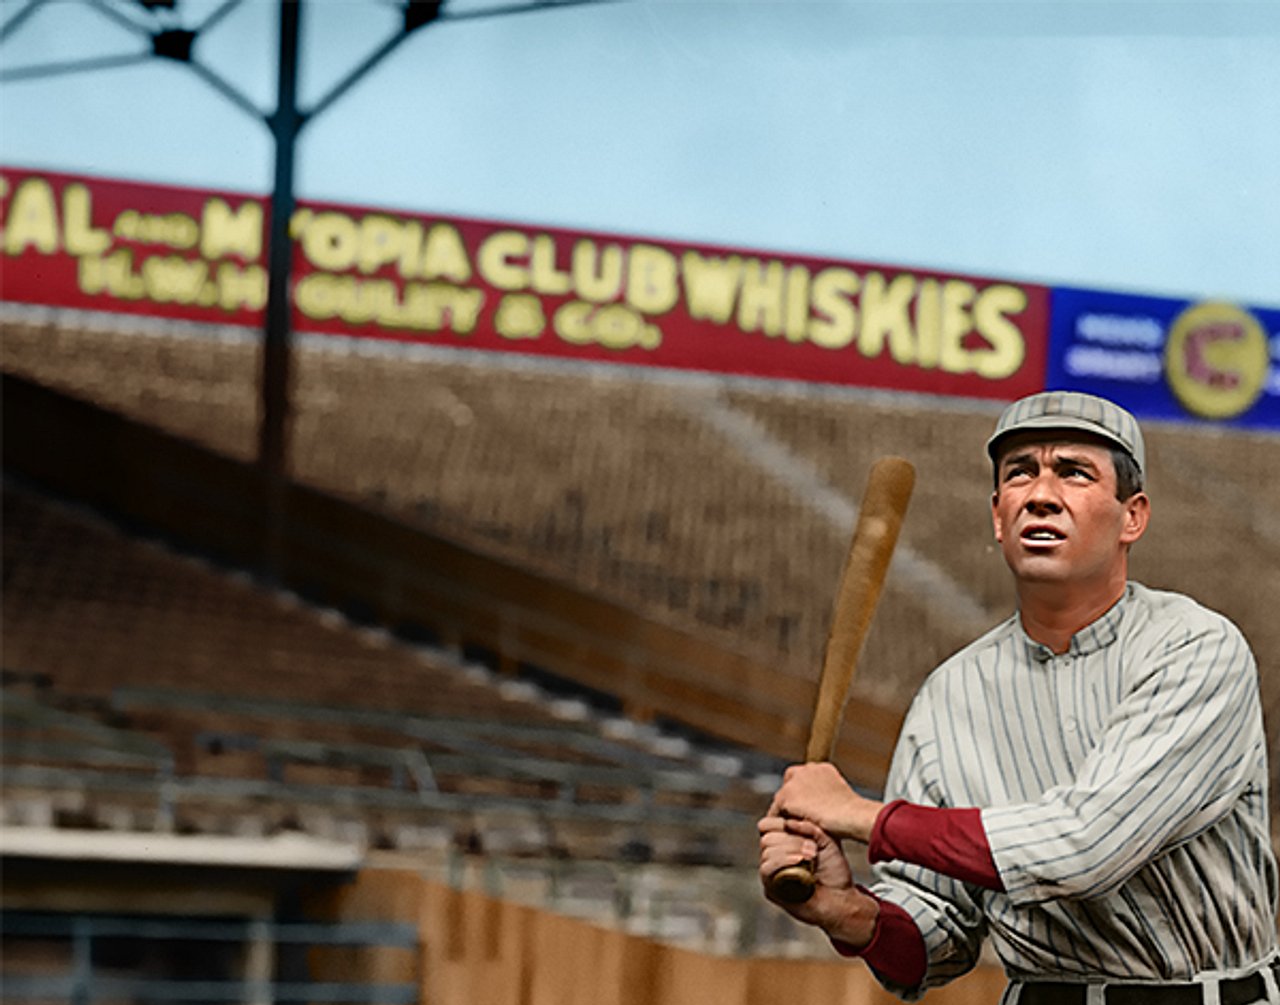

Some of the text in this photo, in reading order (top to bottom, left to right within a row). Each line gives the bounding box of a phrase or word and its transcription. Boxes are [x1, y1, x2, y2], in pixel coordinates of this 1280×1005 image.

[0, 175, 111, 256] AL
[478, 231, 679, 315] CLUB
[682, 250, 1028, 380] WHISKIES
